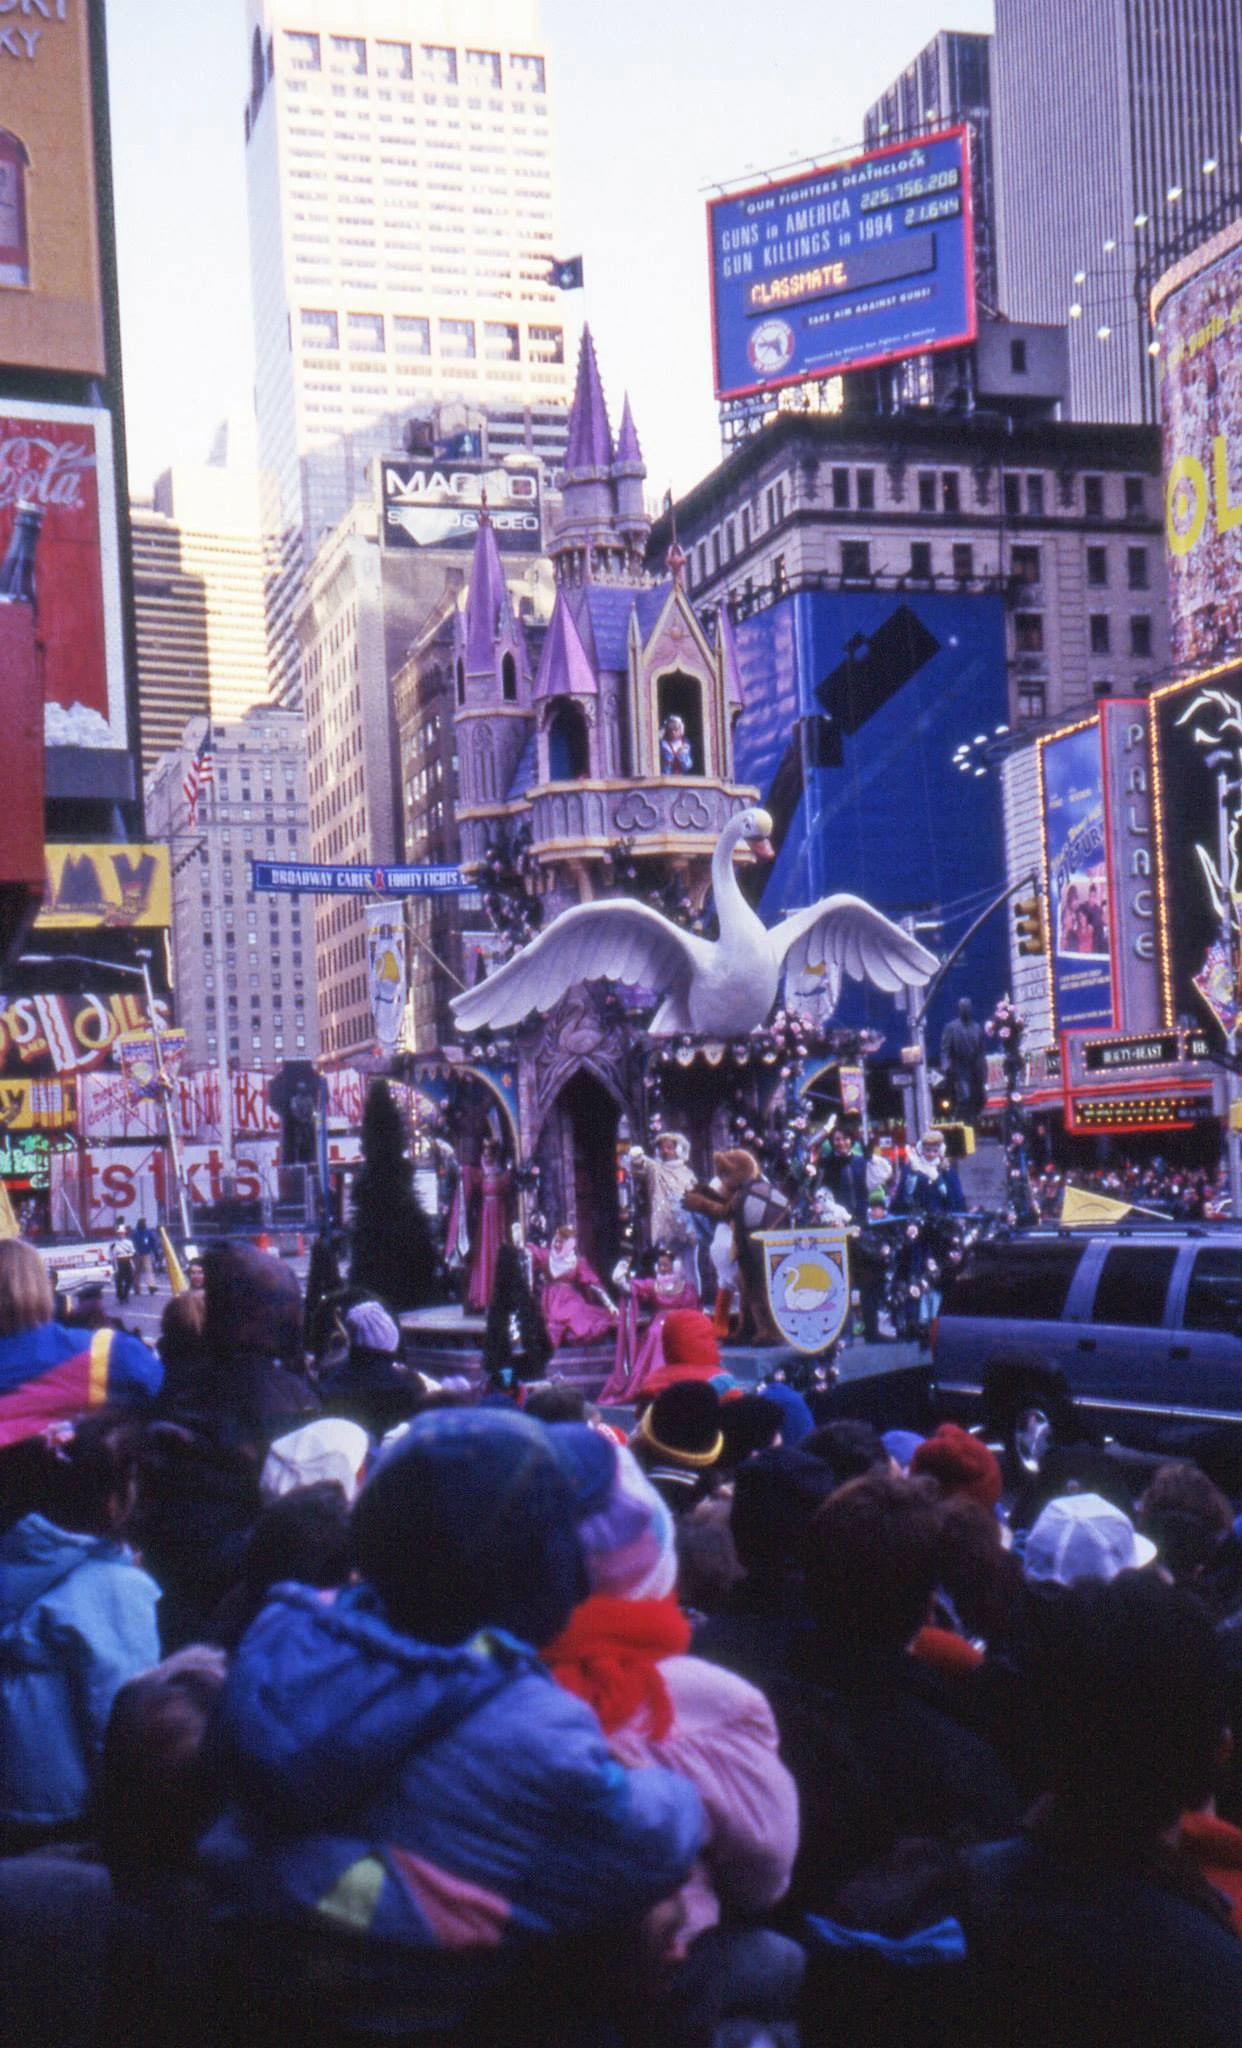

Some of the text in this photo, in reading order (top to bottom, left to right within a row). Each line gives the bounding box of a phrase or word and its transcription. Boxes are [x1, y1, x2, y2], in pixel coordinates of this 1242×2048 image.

[746, 199, 775, 215] GUN
[779, 179, 839, 207] FIGHTERS
[722, 196, 851, 253] GUNS in AMERICA
[723, 212, 893, 278] GUN KILLINGS in 1994
[855, 295, 897, 314] AGAINST
[488, 515, 539, 531] IDEO
[1123, 722, 1156, 962] PALACE
[271, 868, 334, 887] BROADWAY
[336, 871, 372, 888] CARES
[387, 873, 422, 889] EQUITY
[423, 871, 459, 888] FIGHTS
